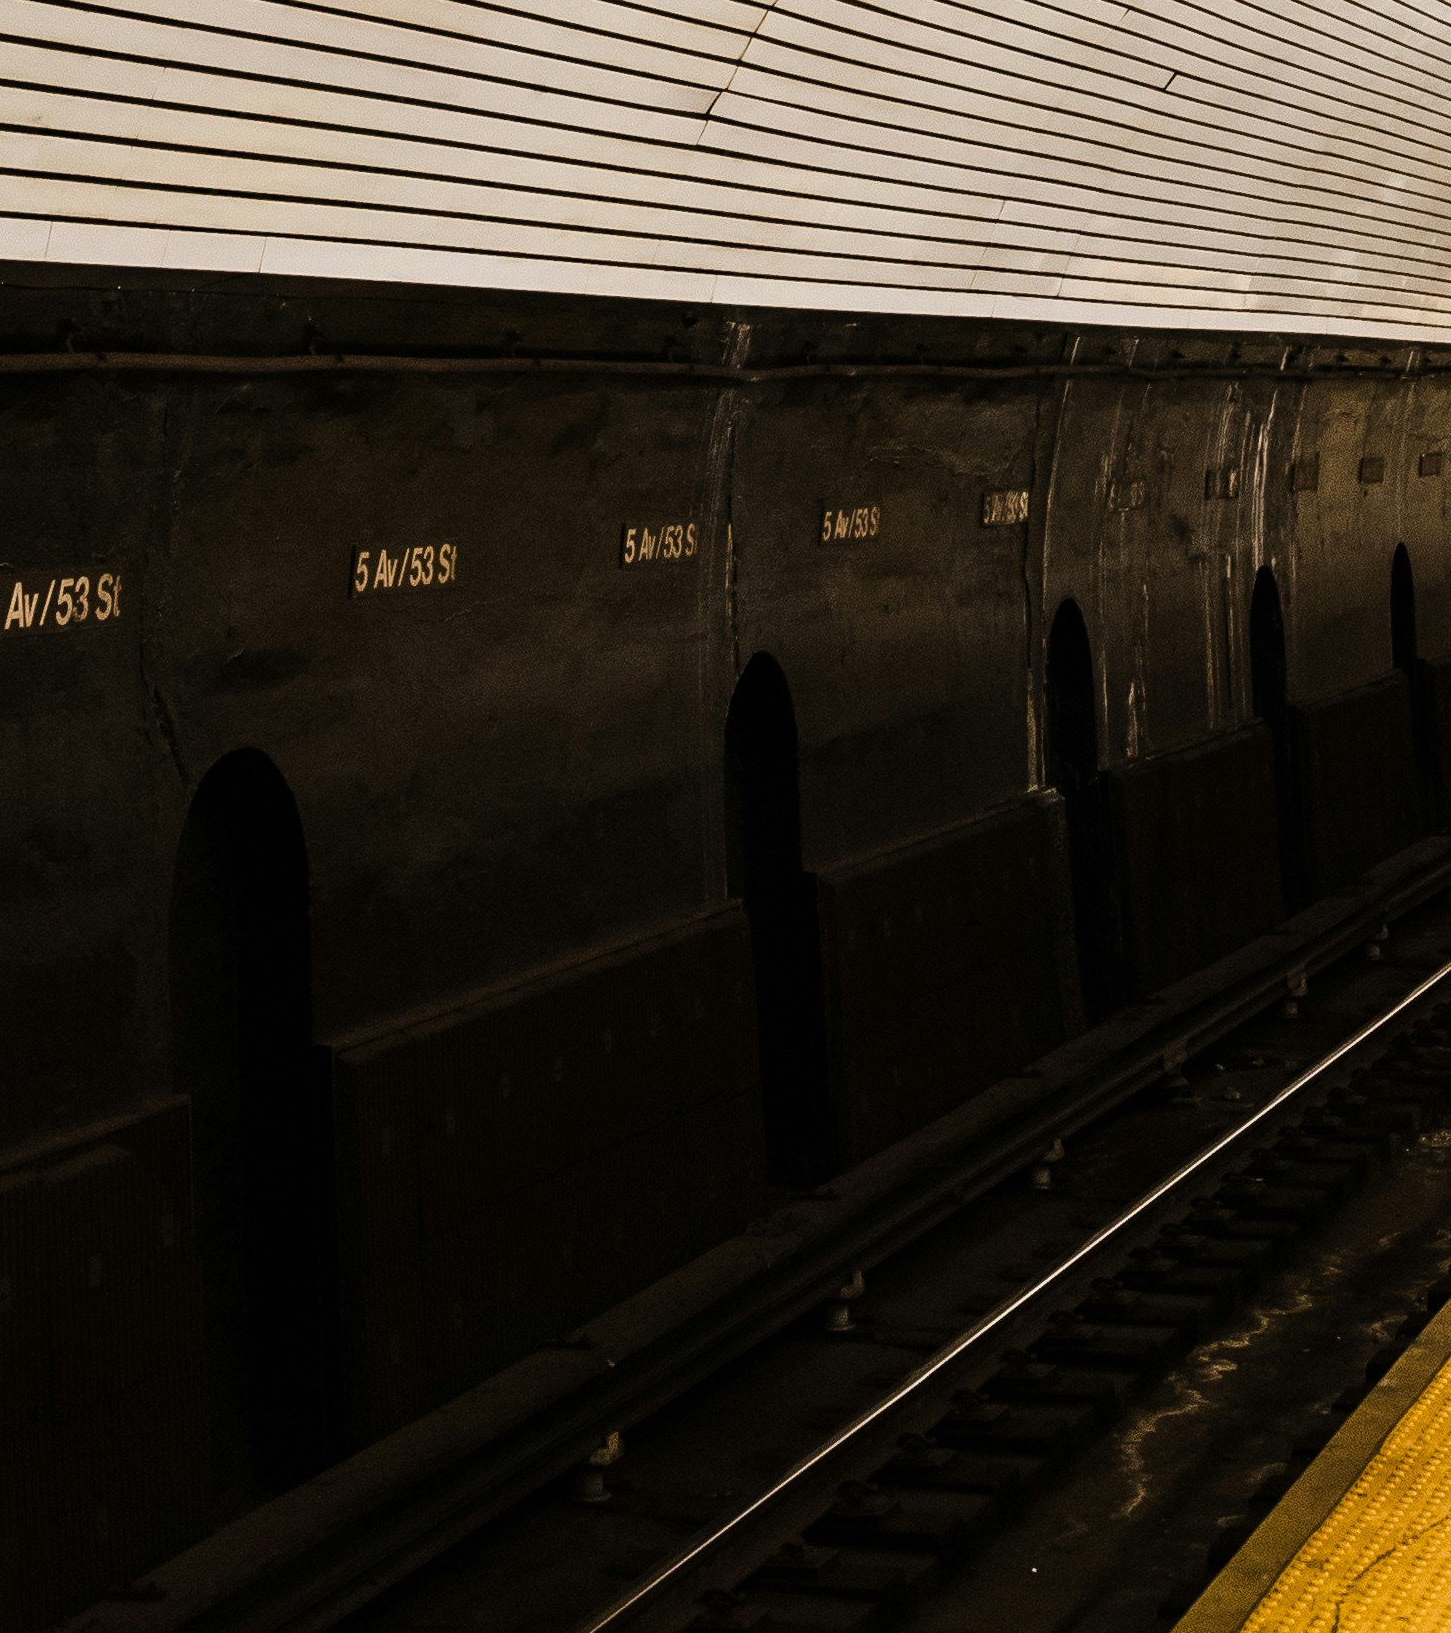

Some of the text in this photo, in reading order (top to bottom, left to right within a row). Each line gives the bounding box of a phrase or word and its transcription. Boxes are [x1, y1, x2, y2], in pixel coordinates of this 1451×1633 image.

[624, 528, 637, 564] 5
[822, 511, 832, 541] 5
[355, 551, 370, 592] 5
[438, 543, 457, 584] St
[95, 573, 122, 621] St
